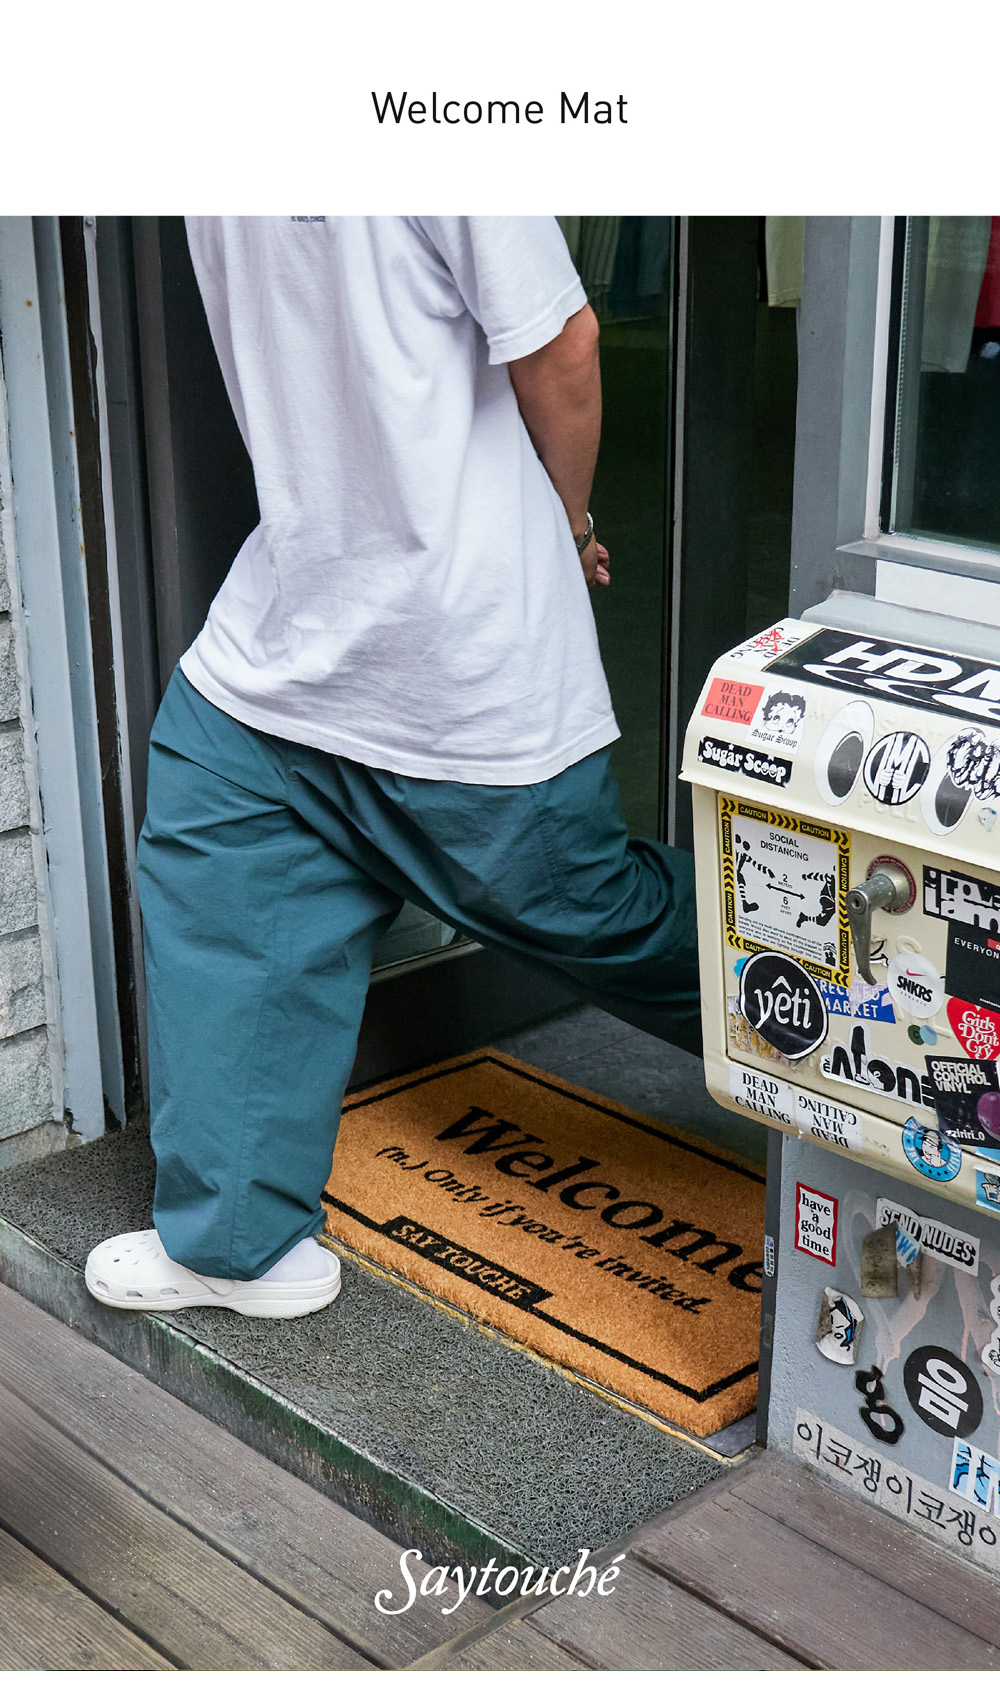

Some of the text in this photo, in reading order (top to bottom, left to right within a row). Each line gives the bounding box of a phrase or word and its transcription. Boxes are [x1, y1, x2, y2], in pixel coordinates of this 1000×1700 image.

[720, 682, 751, 696] DEAD
[705, 703, 751, 722] CALLING
[719, 695, 744, 708] MAN
[751, 728, 798, 748] Sugar Scoop
[702, 741, 786, 785] Sugar Scoop
[739, 805, 830, 839] CAUTION CAUTION
[760, 840, 809, 862] DISTANCING
[769, 832, 799, 848] SOCIAL
[782, 873, 788, 883] 2
[783, 896, 789, 905] 6
[804, 963, 831, 978] CAUTION
[896, 976, 933, 1003] SNKRS
[753, 975, 812, 1030] yêti
[962, 1010, 995, 1033] Girls
[958, 1022, 999, 1047] Don't
[965, 1038, 994, 1060] Cry
[930, 1060, 985, 1075] OFFICIAL
[933, 1071, 991, 1086] CONTROL
[742, 1072, 778, 1095] DEAD
[935, 1081, 972, 1094] VINYL
[746, 1087, 775, 1108] MAN
[735, 1095, 791, 1125] CALLING
[798, 1095, 857, 1126] CALLING
[813, 1114, 843, 1135] MAN
[810, 1126, 849, 1148] DEAD
[376, 1146, 429, 1170] (n.)
[424, 1169, 490, 1203] Only
[478, 1200, 526, 1217] if
[801, 1193, 831, 1216] have
[811, 1213, 819, 1223] a
[391, 1225, 441, 1248] SAY
[496, 1214, 600, 1260] you're
[800, 1219, 831, 1241] good
[802, 1234, 830, 1256] time
[921, 1224, 976, 1267] NUDES
